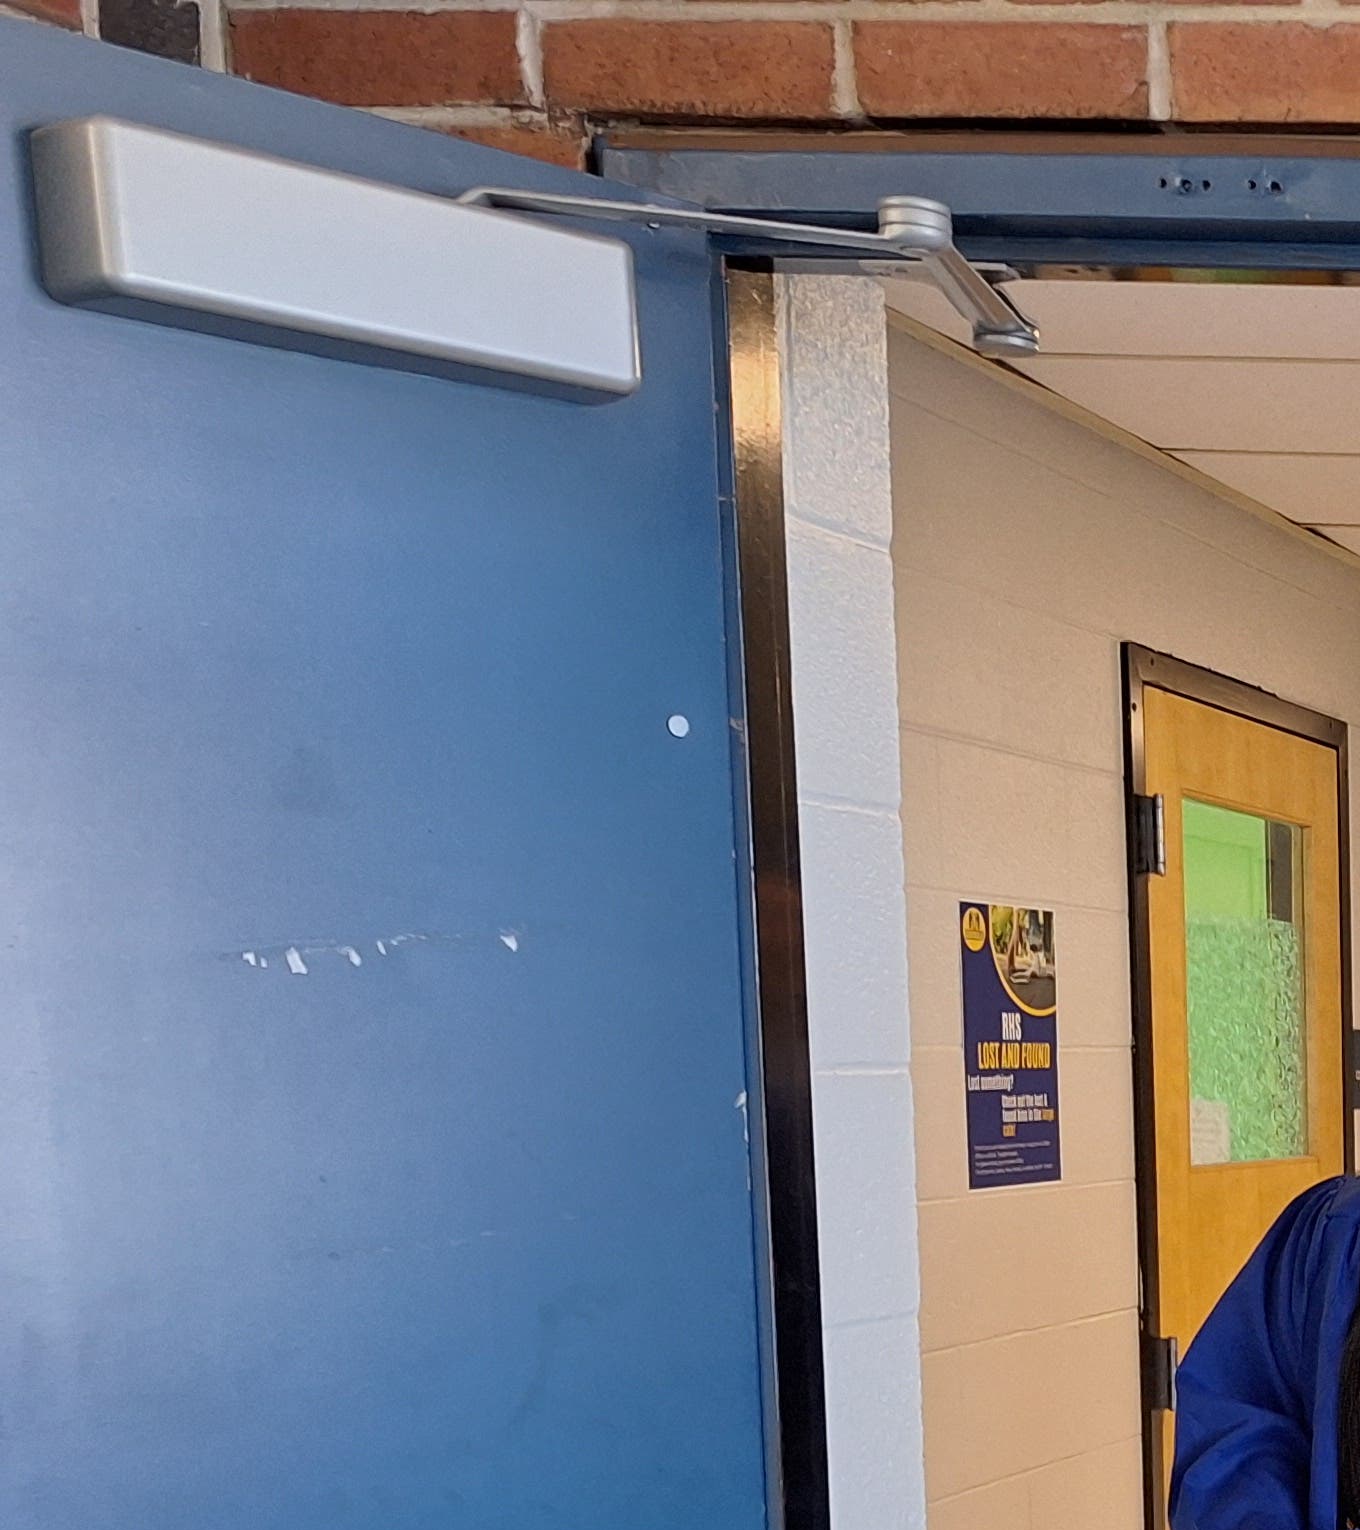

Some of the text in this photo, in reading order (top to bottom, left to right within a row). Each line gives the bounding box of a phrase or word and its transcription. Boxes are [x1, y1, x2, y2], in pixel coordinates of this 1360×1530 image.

[1002, 1012, 1022, 1040] RHS
[978, 1042, 1051, 1069] LOST AND FOUND
